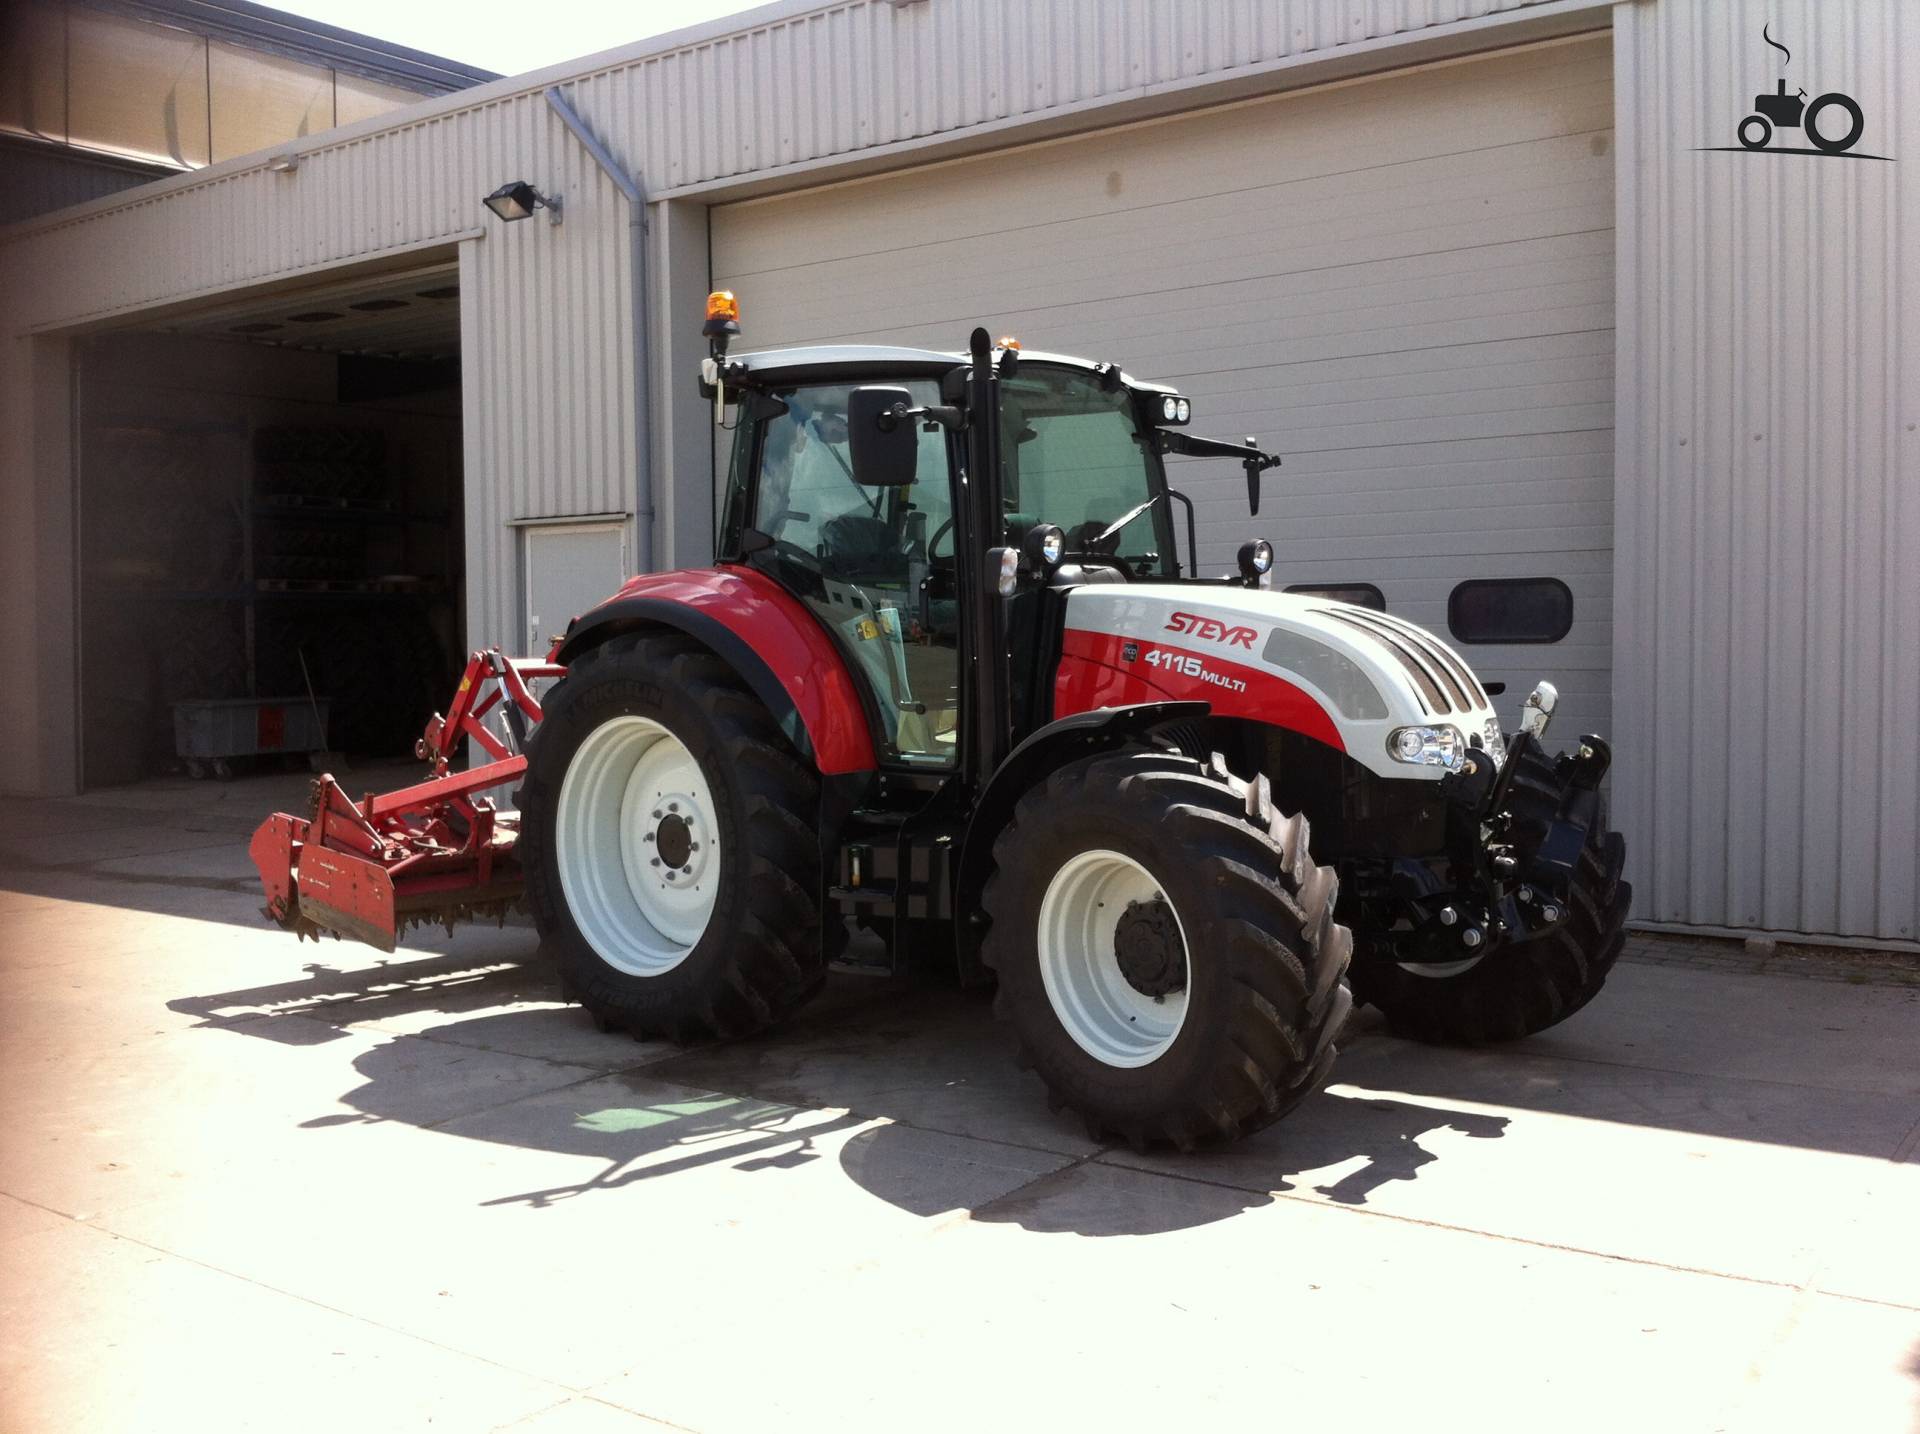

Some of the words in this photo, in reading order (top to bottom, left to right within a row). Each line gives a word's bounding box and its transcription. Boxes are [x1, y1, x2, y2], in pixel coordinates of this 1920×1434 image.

[1164, 611, 1258, 649] STEYR
[1144, 649, 1202, 677] 4115
[1201, 670, 1246, 693] MULTI
[582, 680, 664, 708] MICHELIN
